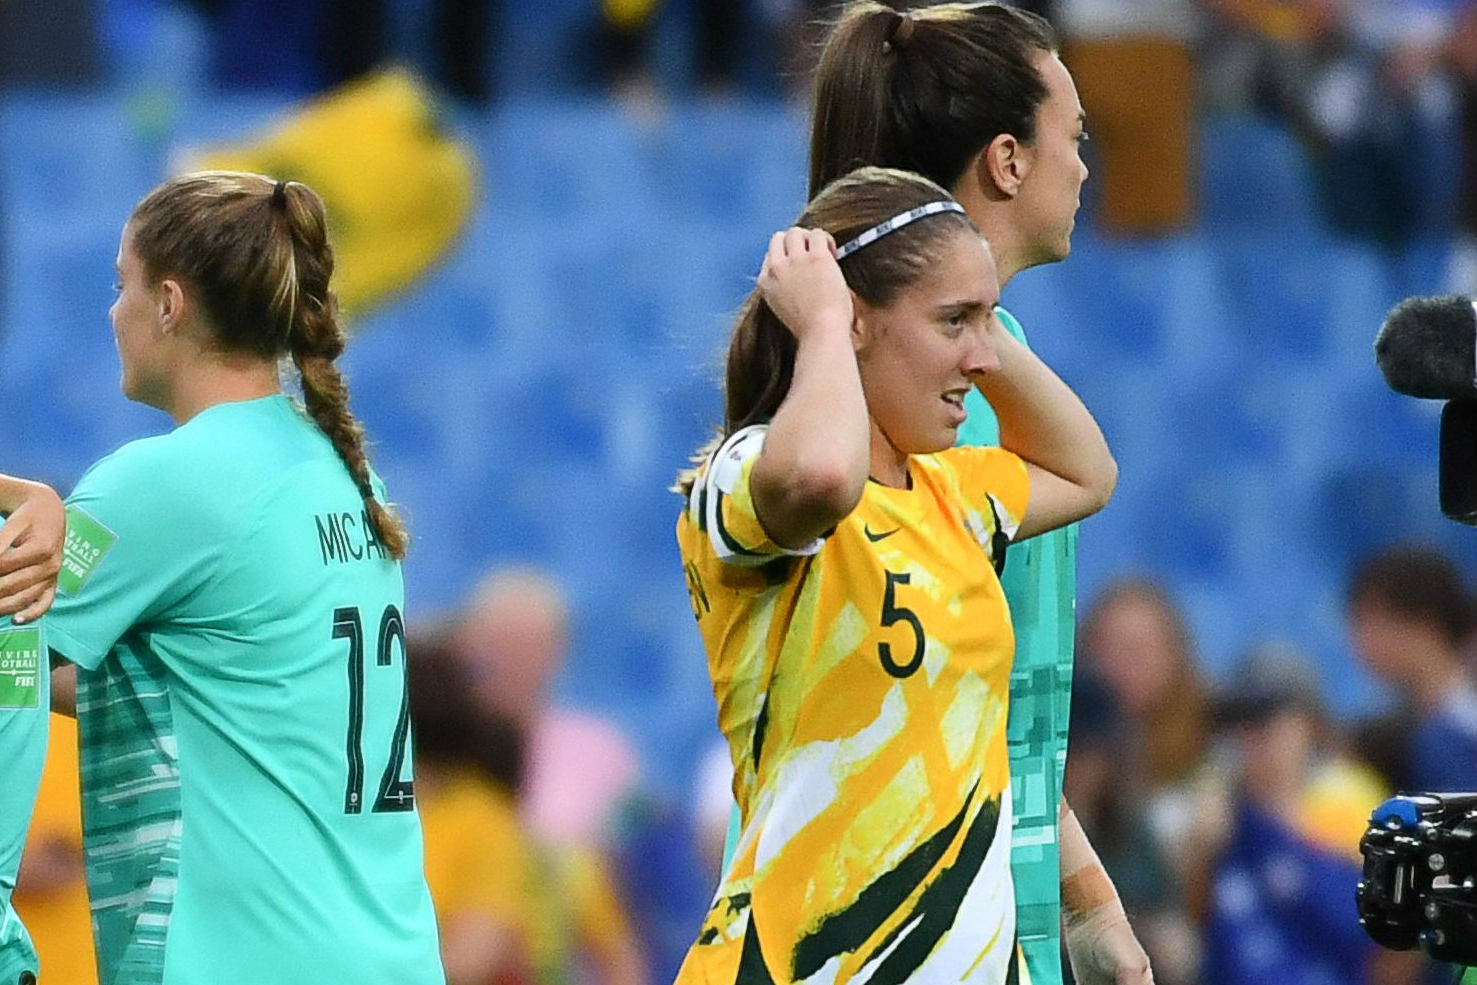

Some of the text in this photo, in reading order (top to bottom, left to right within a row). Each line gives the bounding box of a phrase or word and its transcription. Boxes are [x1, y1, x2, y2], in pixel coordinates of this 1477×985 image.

[68, 529, 100, 556] VING
[314, 510, 387, 566] MICA
[877, 569, 925, 679] 5
[331, 603, 414, 814] 12
